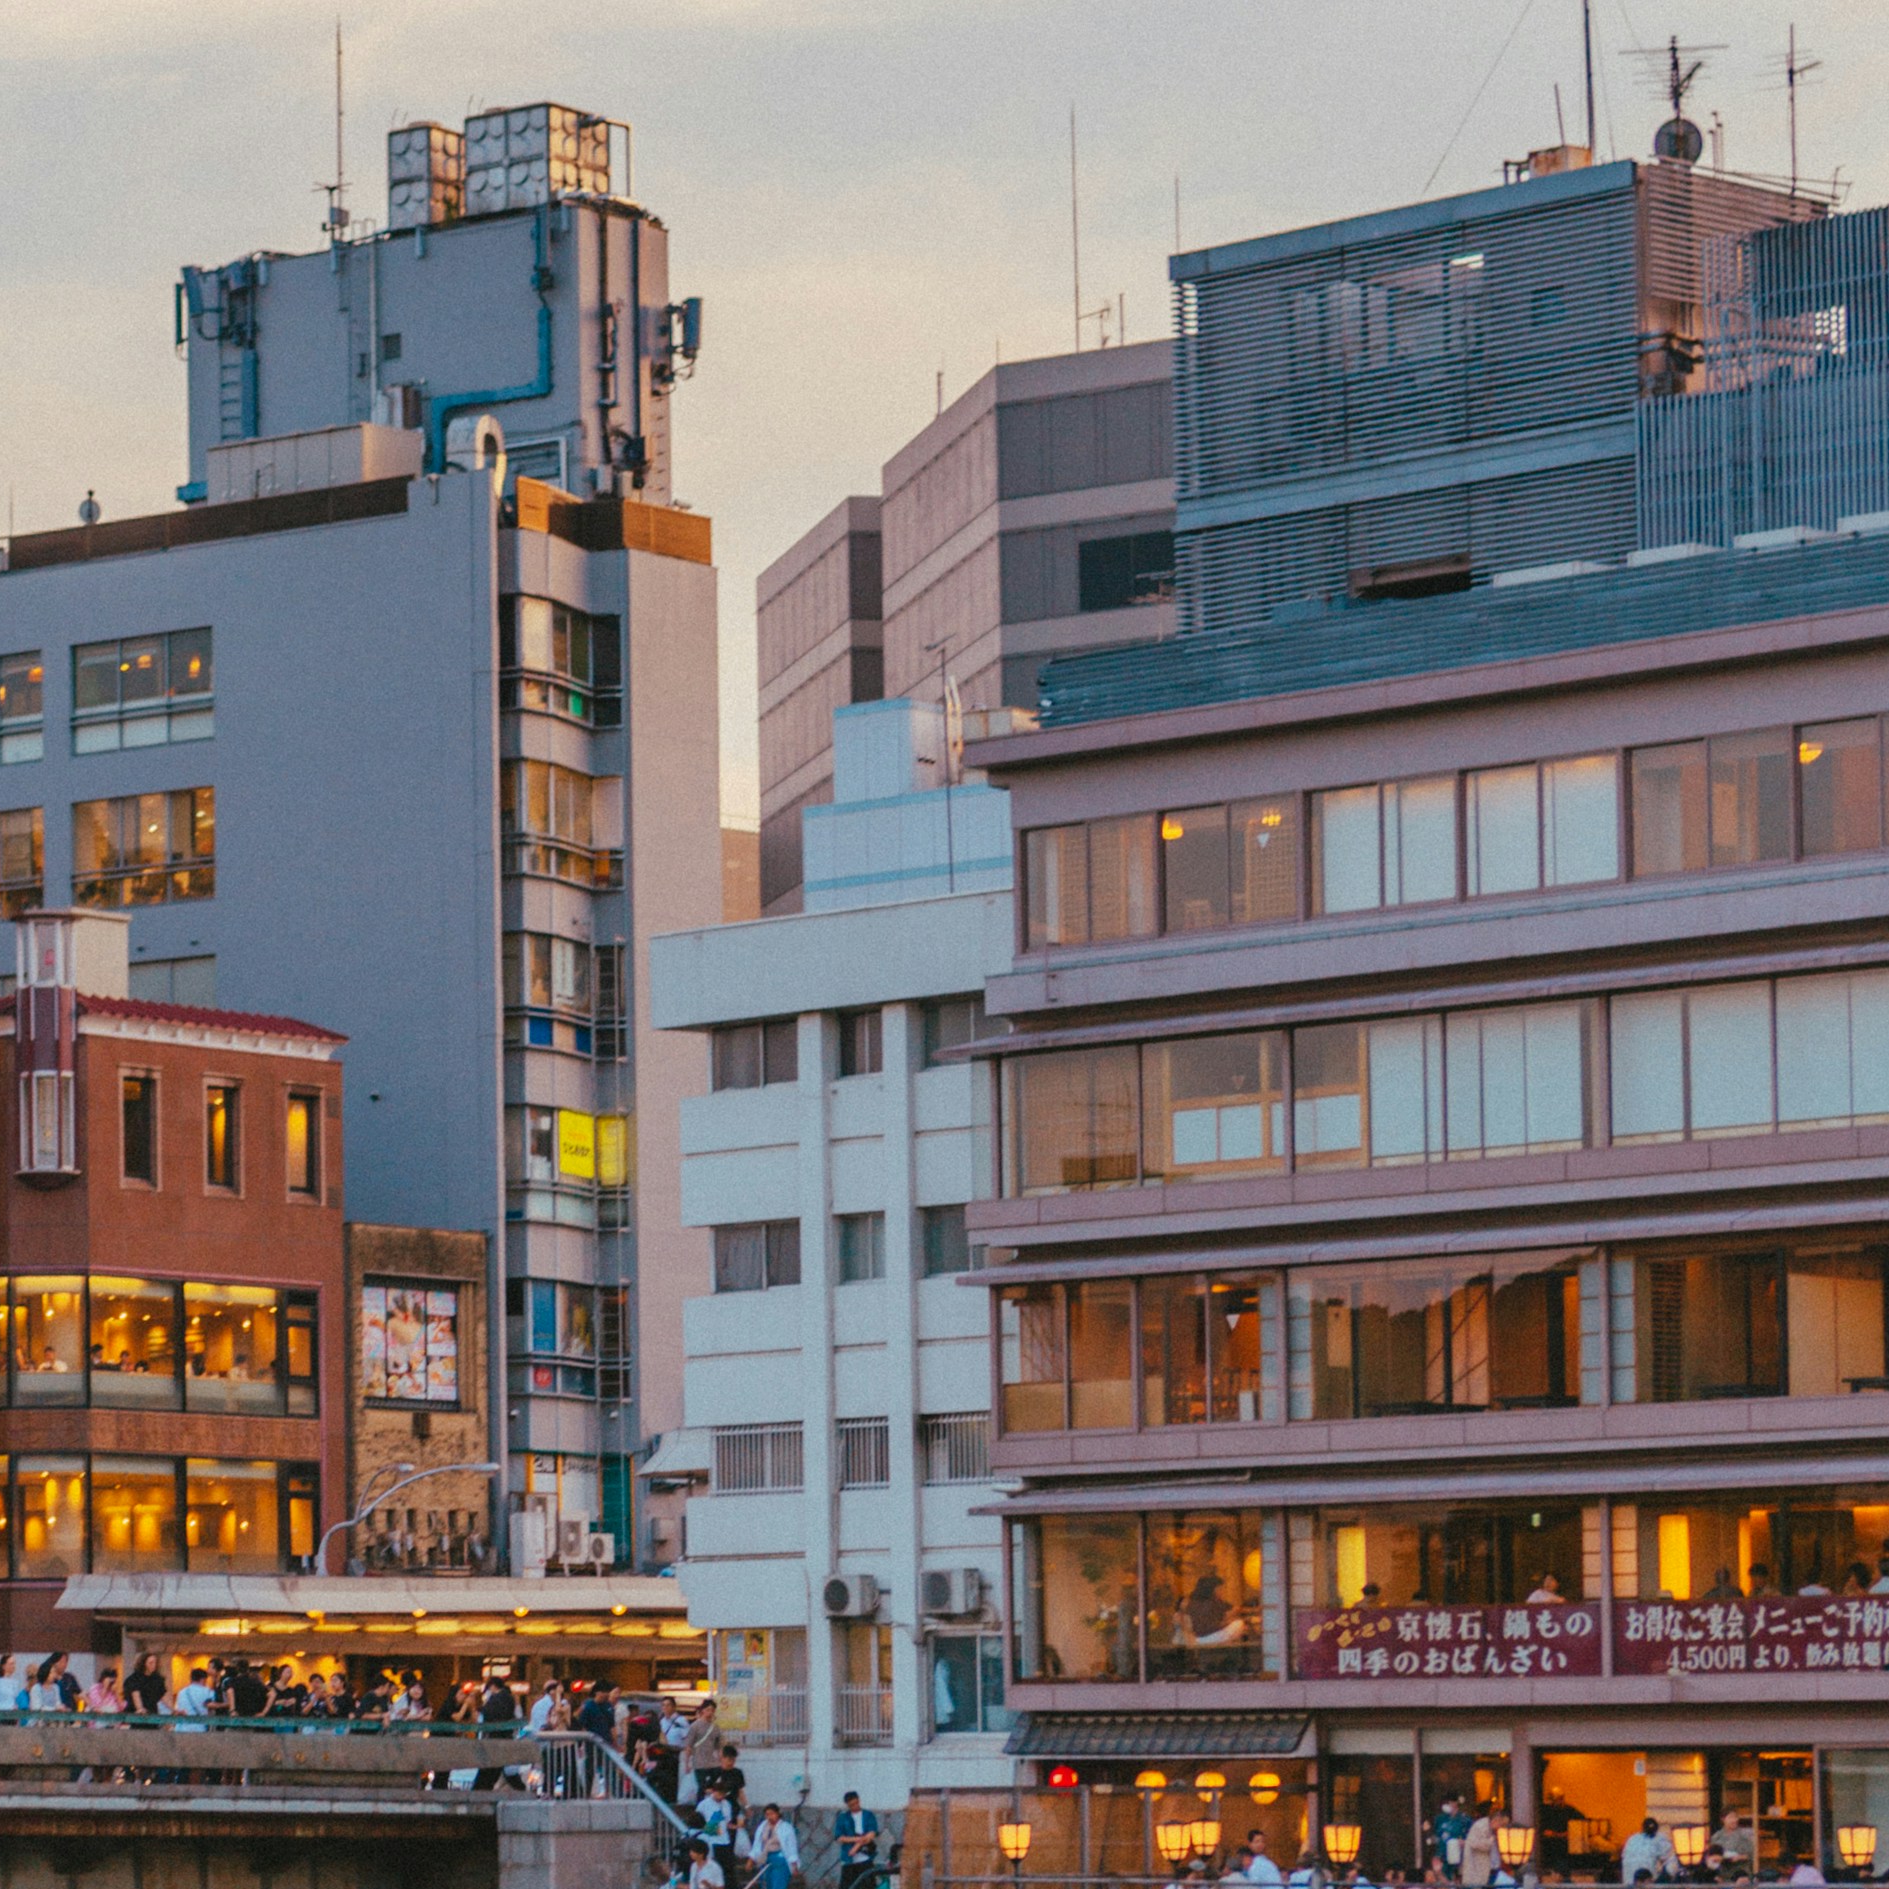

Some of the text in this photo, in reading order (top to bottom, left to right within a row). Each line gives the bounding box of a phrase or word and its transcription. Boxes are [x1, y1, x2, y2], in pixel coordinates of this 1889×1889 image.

[1338, 1644, 1568, 1677] 四季のおばんざい
